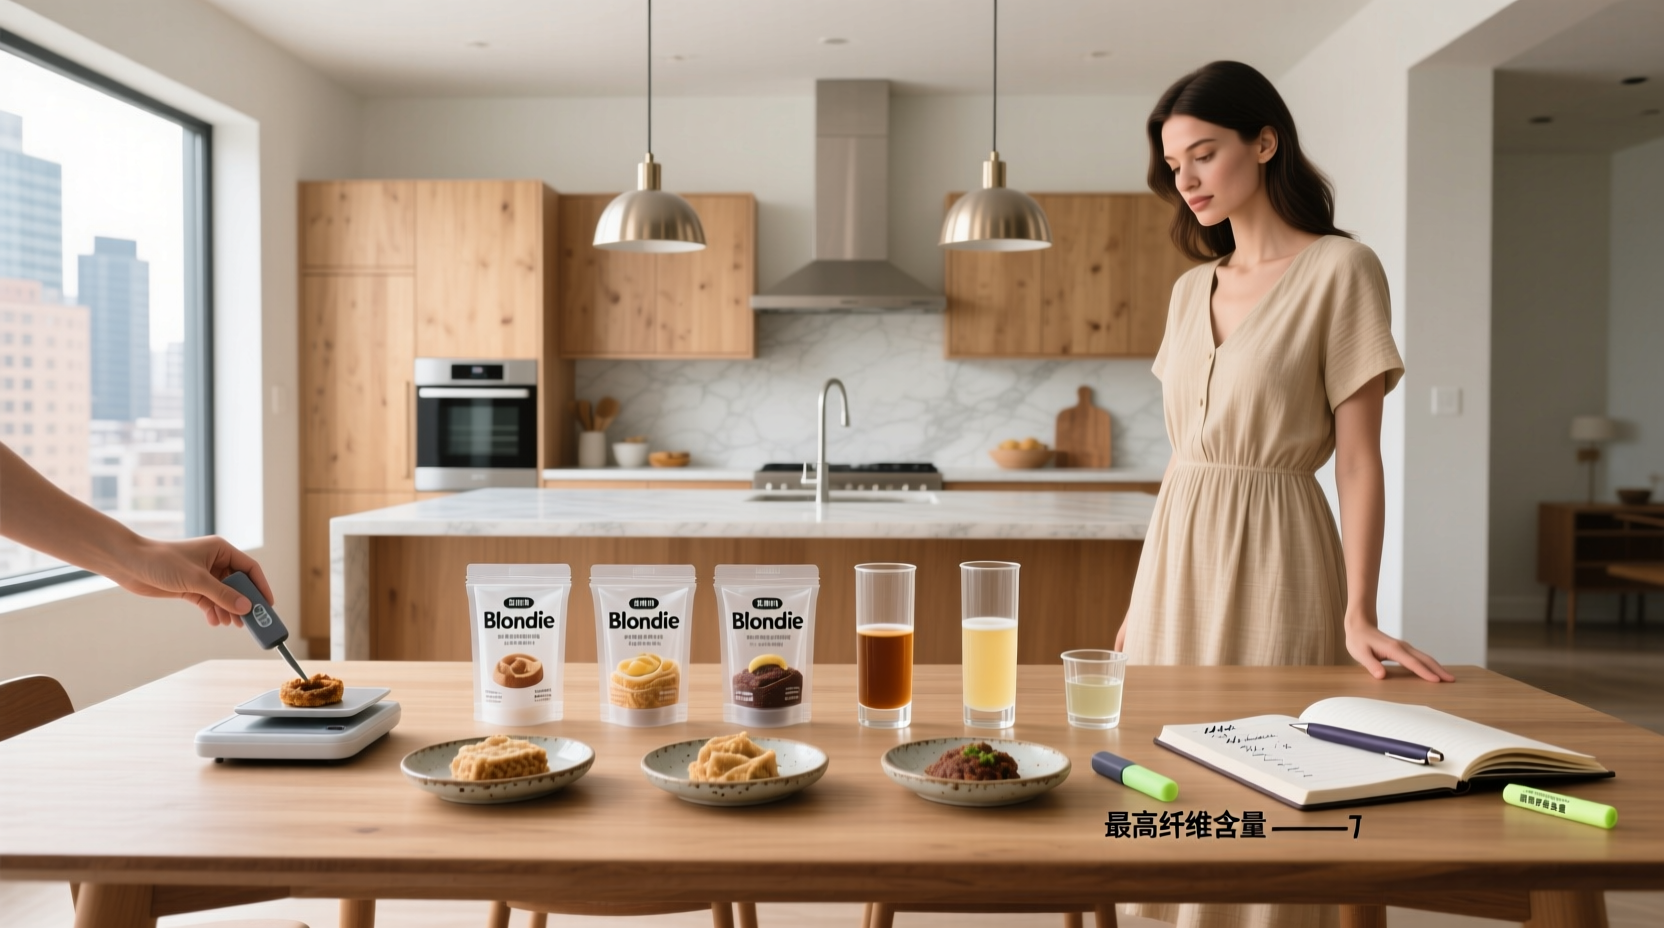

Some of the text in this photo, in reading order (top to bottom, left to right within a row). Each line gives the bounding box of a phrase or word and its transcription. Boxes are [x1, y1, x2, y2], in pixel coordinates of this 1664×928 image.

[484, 611, 555, 629] Blondie
[609, 611, 680, 629] Blondie
[732, 611, 804, 630] Blondie
